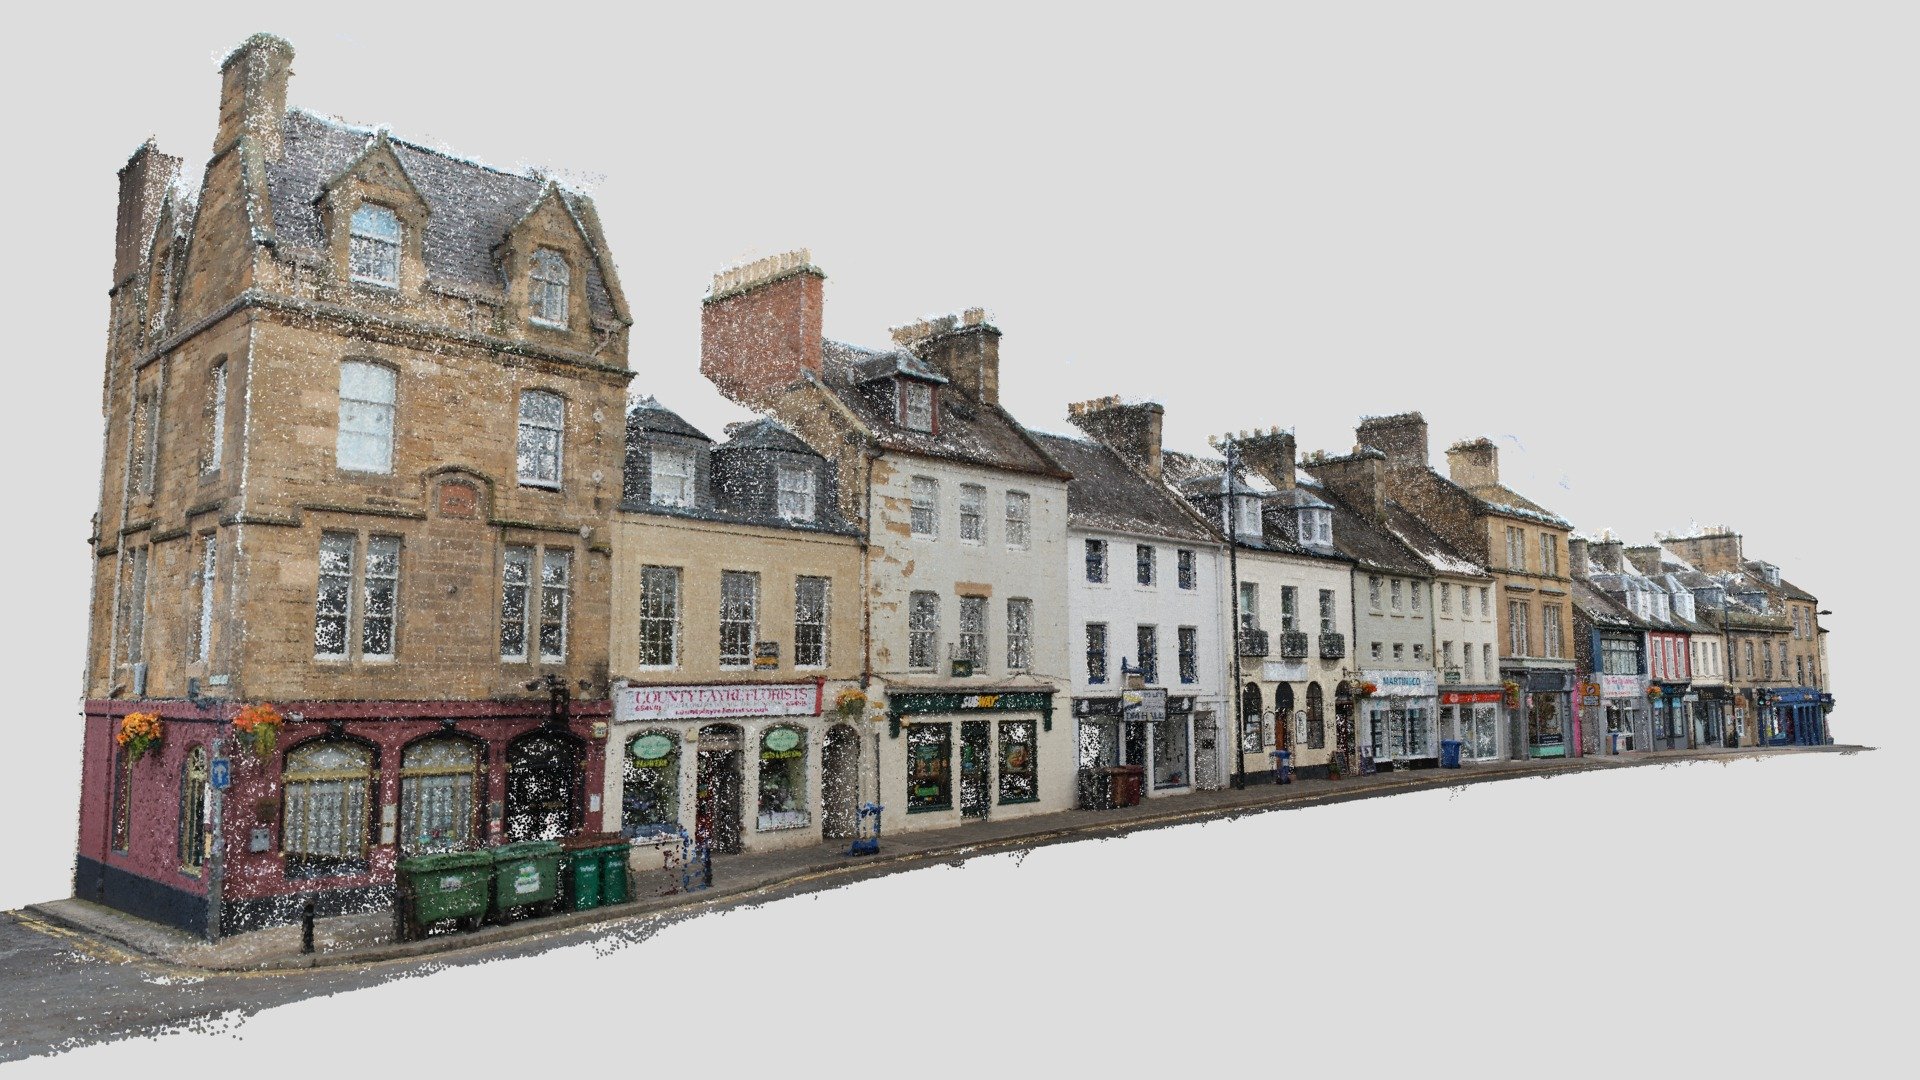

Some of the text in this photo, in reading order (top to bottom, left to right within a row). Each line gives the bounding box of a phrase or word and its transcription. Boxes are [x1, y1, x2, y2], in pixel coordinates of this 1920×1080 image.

[635, 687, 808, 704] COUNTY FAYRE FLORISTS
[960, 694, 999, 709] SUBWAY
